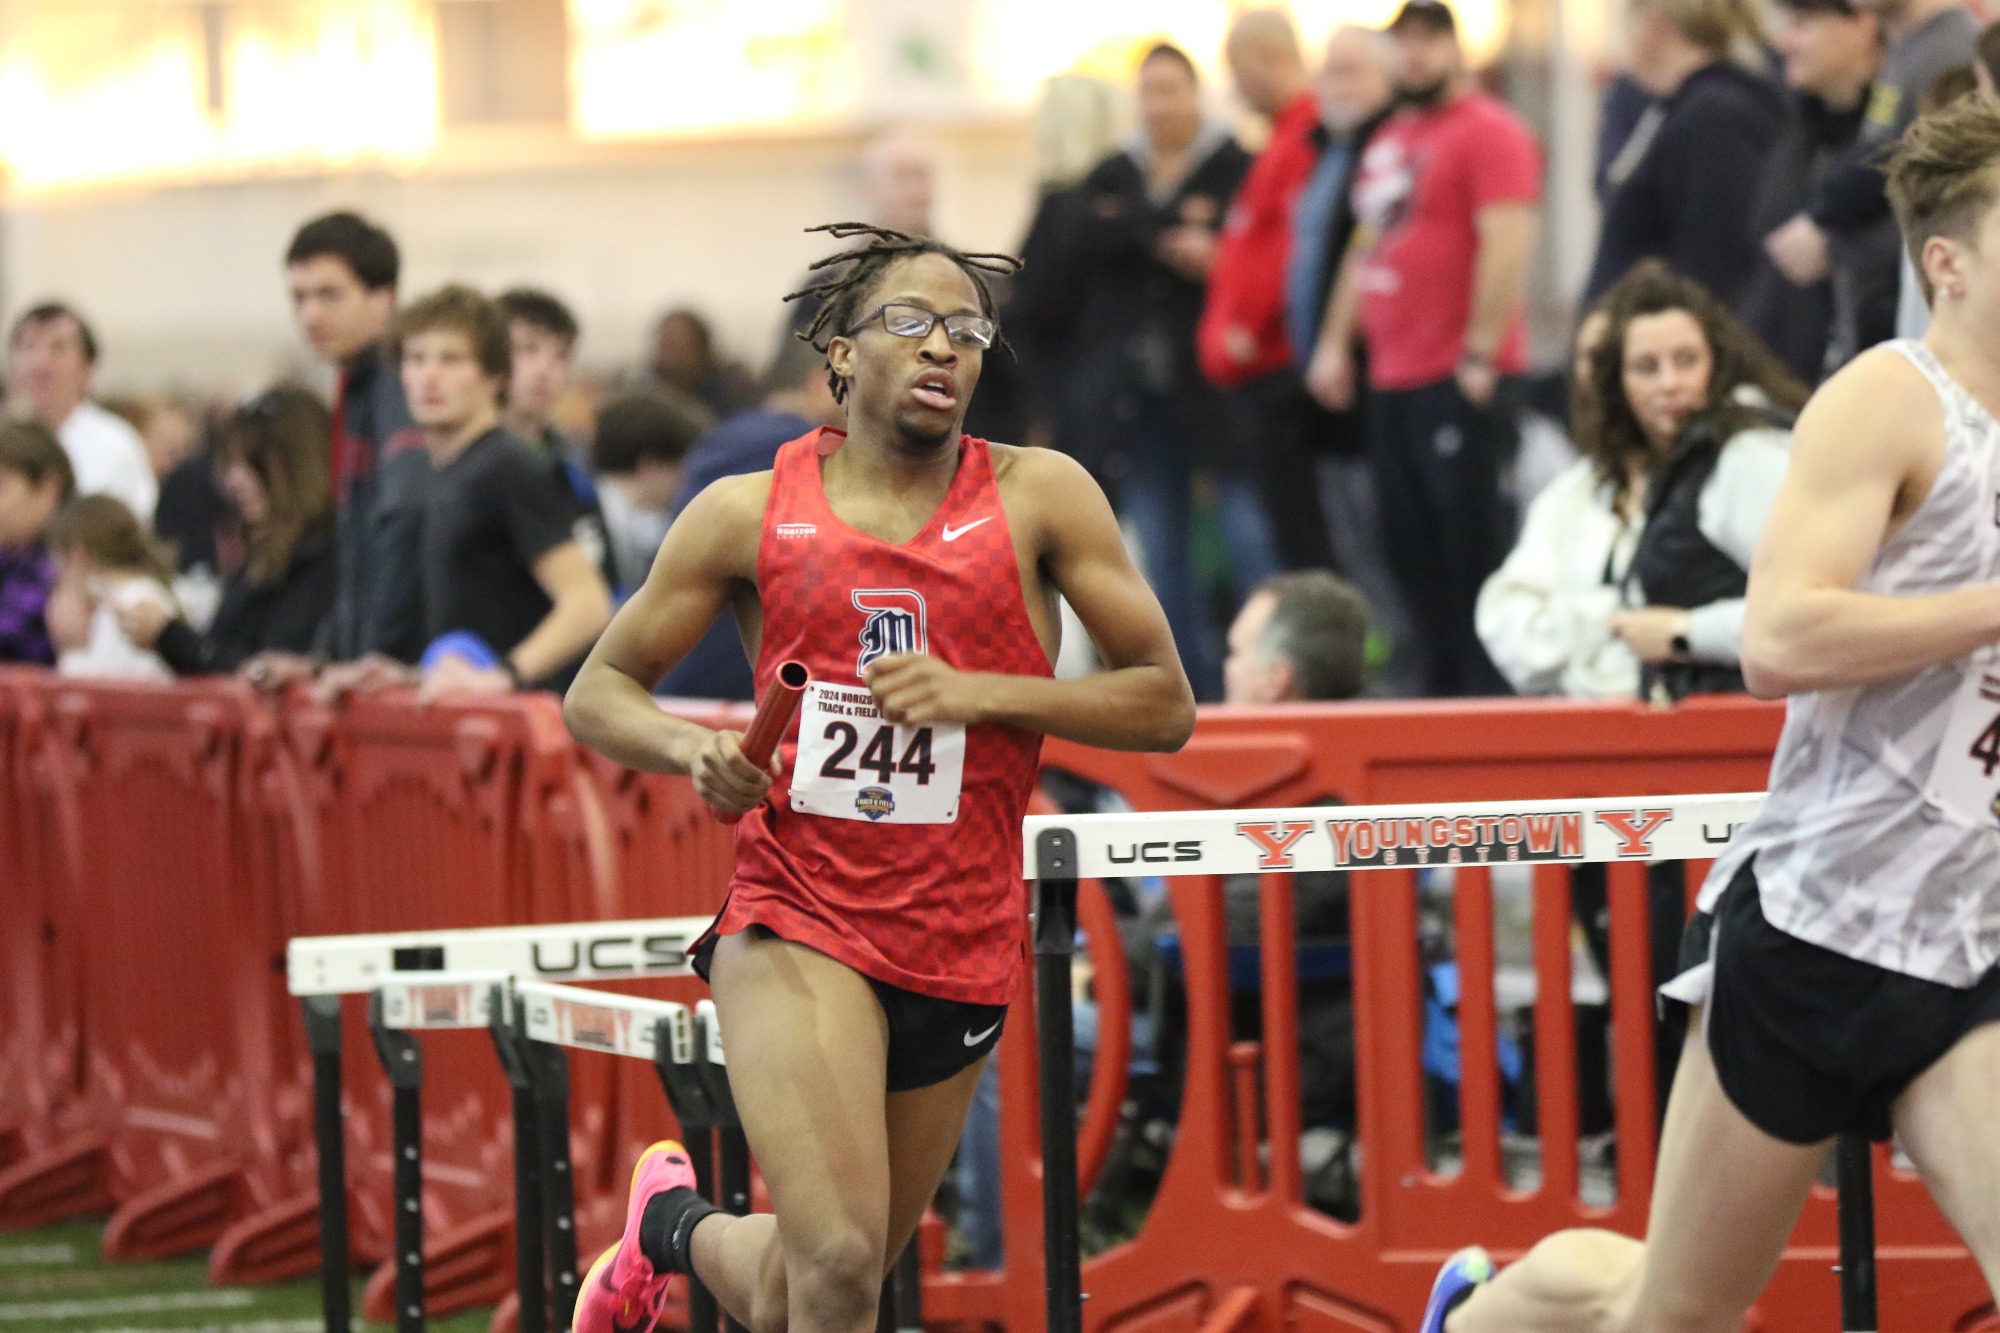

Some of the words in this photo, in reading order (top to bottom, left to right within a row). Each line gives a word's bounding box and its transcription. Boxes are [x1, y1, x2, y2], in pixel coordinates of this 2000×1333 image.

[817, 701, 845, 715] TRACK
[846, 706, 853, 717] &
[854, 706, 878, 719] FIELD
[819, 689, 840, 702] 2024
[841, 692, 874, 706] HORIZO
[819, 720, 936, 786] 244
[1107, 840, 1204, 864] UCS
[1236, 820, 1314, 869] Y
[1327, 811, 1585, 867] YOUNGSTOWN
[1596, 808, 1673, 857] Y
[1382, 845, 1520, 865] STATE
[532, 935, 687, 973] UCS
